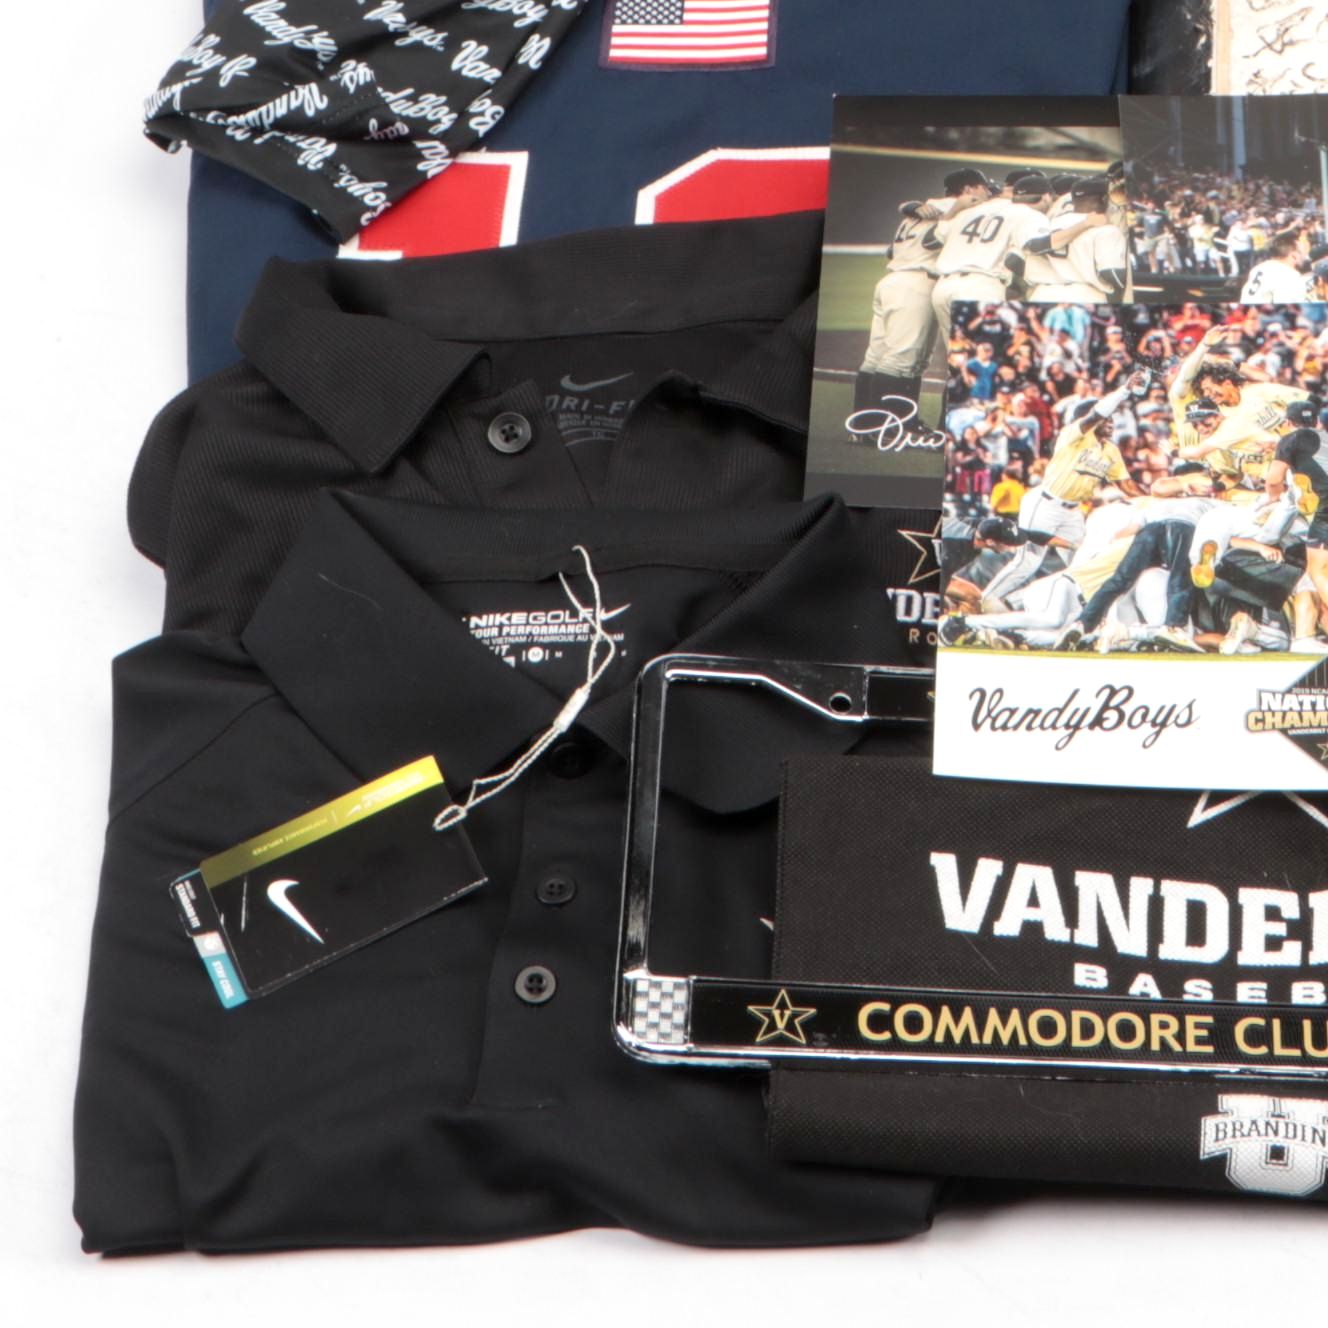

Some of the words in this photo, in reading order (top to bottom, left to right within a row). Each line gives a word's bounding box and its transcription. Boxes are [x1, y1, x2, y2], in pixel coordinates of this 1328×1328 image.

[961, 214, 1005, 244] 40
[492, 636, 527, 645] VIETNAM
[533, 634, 574, 643] FABRIQUE
[503, 623, 590, 636] PERFORMANCE
[969, 684, 1199, 752] VandyBoys
[775, 1008, 792, 1031] V
[857, 1002, 1214, 1053] COMMODORE
